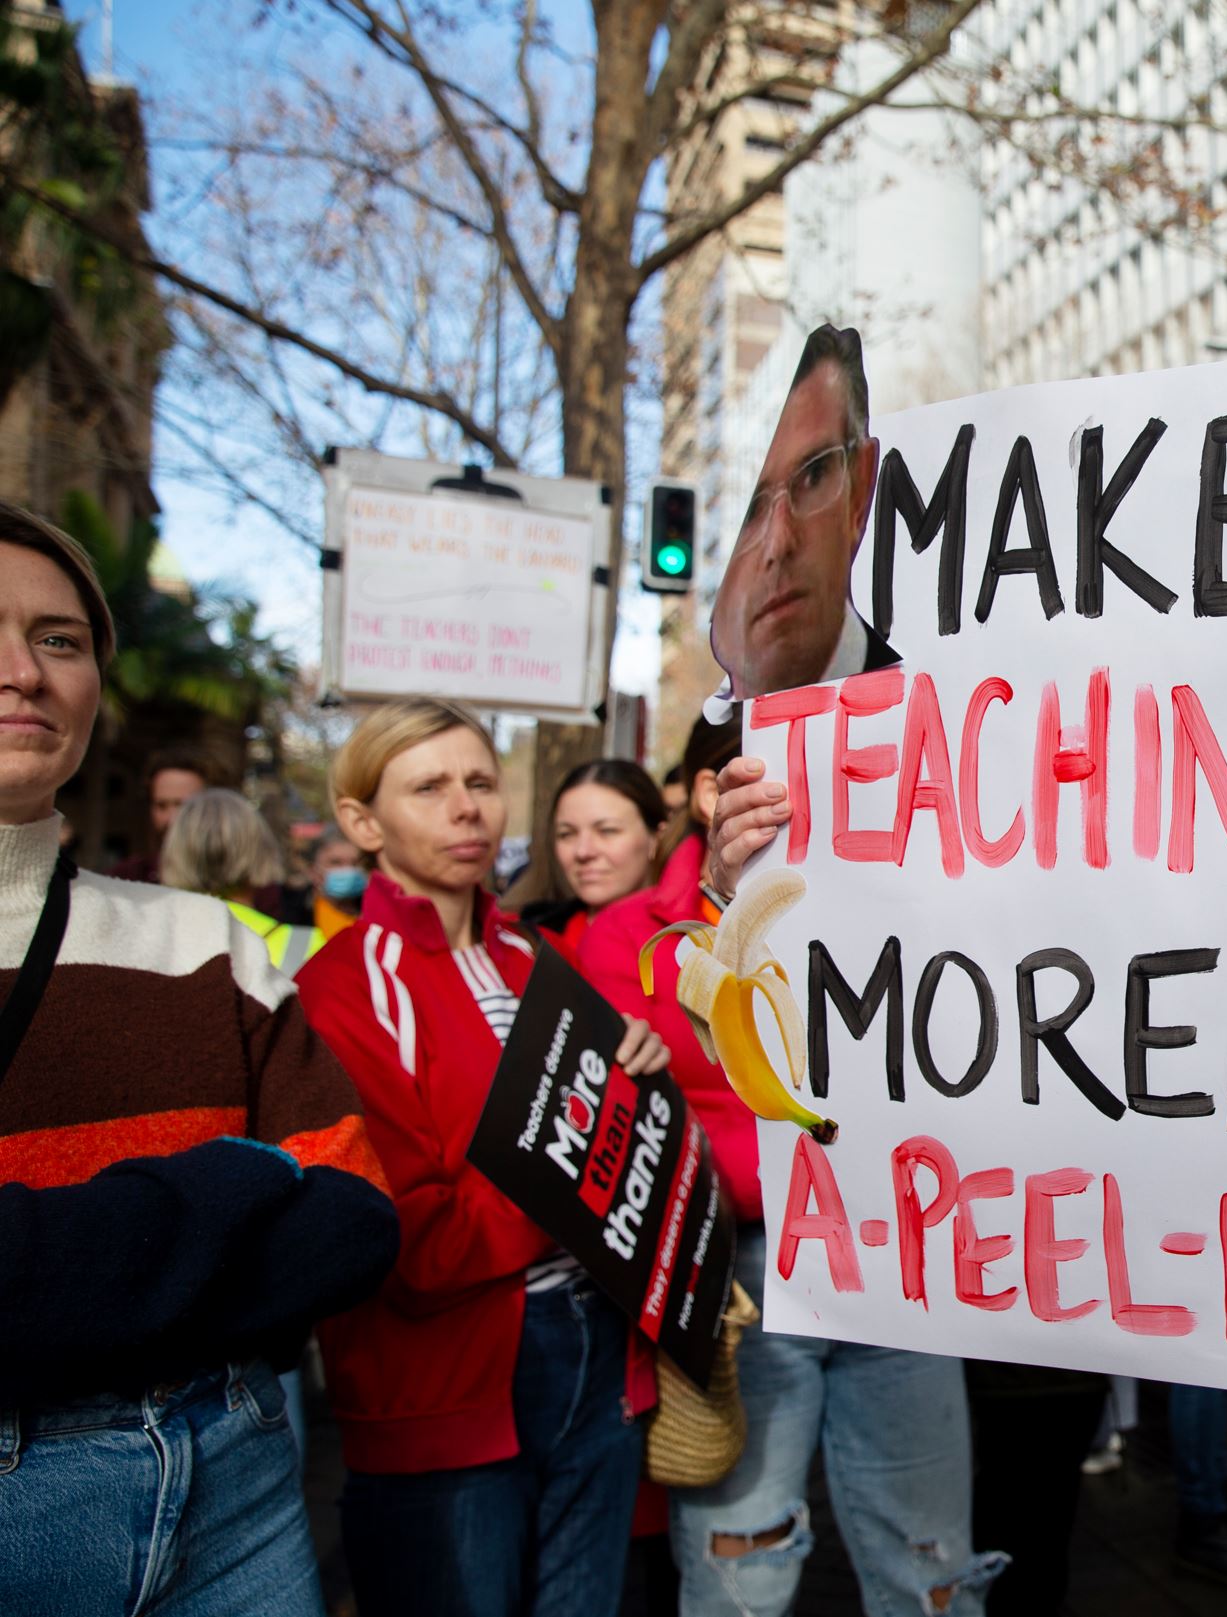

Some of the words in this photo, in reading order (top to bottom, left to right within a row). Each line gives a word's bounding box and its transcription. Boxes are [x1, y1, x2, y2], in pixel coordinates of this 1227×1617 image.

[807, 935, 1221, 1122] MORE
[517, 1073, 554, 1152] Teachers
[544, 1007, 574, 1075] deserve
[544, 1048, 608, 1180] More
[589, 1102, 632, 1191] than
[602, 1090, 671, 1261] thanks
[681, 1151, 698, 1189] pay
[659, 1198, 685, 1270] deserve
[677, 1185, 689, 1200] a
[646, 1268, 668, 1318] They
